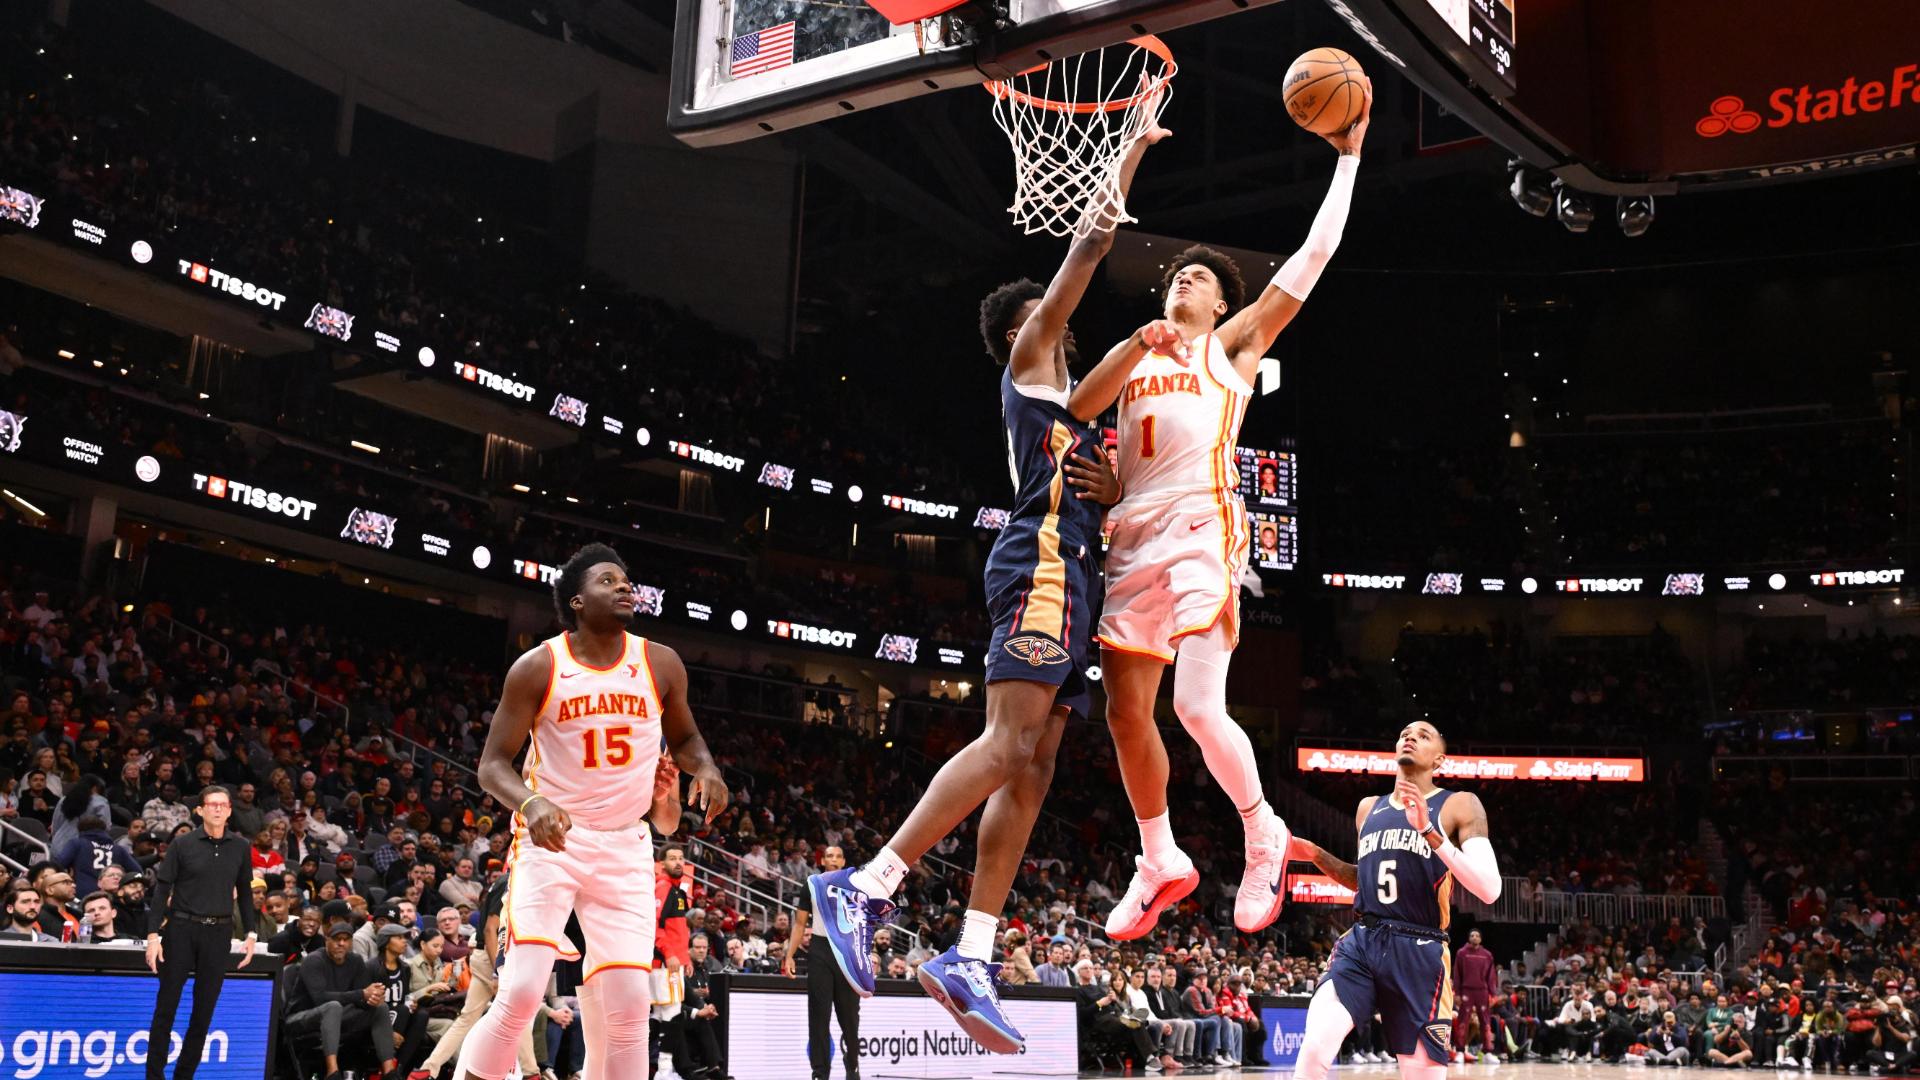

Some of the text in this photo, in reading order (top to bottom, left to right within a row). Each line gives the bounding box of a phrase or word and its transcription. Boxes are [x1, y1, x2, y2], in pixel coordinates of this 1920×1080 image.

[1490, 38, 1511, 68] 9:50
[72, 219, 107, 238] OFFICIAL
[74, 229, 102, 244] WATCH
[209, 268, 286, 311] TISSOT
[477, 368, 536, 401] TISSOT
[63, 437, 104, 456] OFFICIAL
[1141, 414, 1155, 458] 1
[66, 448, 98, 465] WATCH
[690, 445, 744, 472] TISSOT
[228, 480, 317, 521] TISSOT
[902, 498, 958, 519] TISSOT
[422, 534, 450, 548] OFFICIAL
[1344, 574, 1405, 589] TISSOT
[1579, 578, 1643, 592] TISSOT
[1835, 569, 1904, 585] TISSOT
[790, 624, 856, 648] TISSOT
[557, 693, 648, 723] ATLANTA
[581, 726, 635, 770] 15
[1381, 828, 1431, 859] ORLEANS
[93, 849, 112, 869] 21
[1377, 859, 1398, 904] 5
